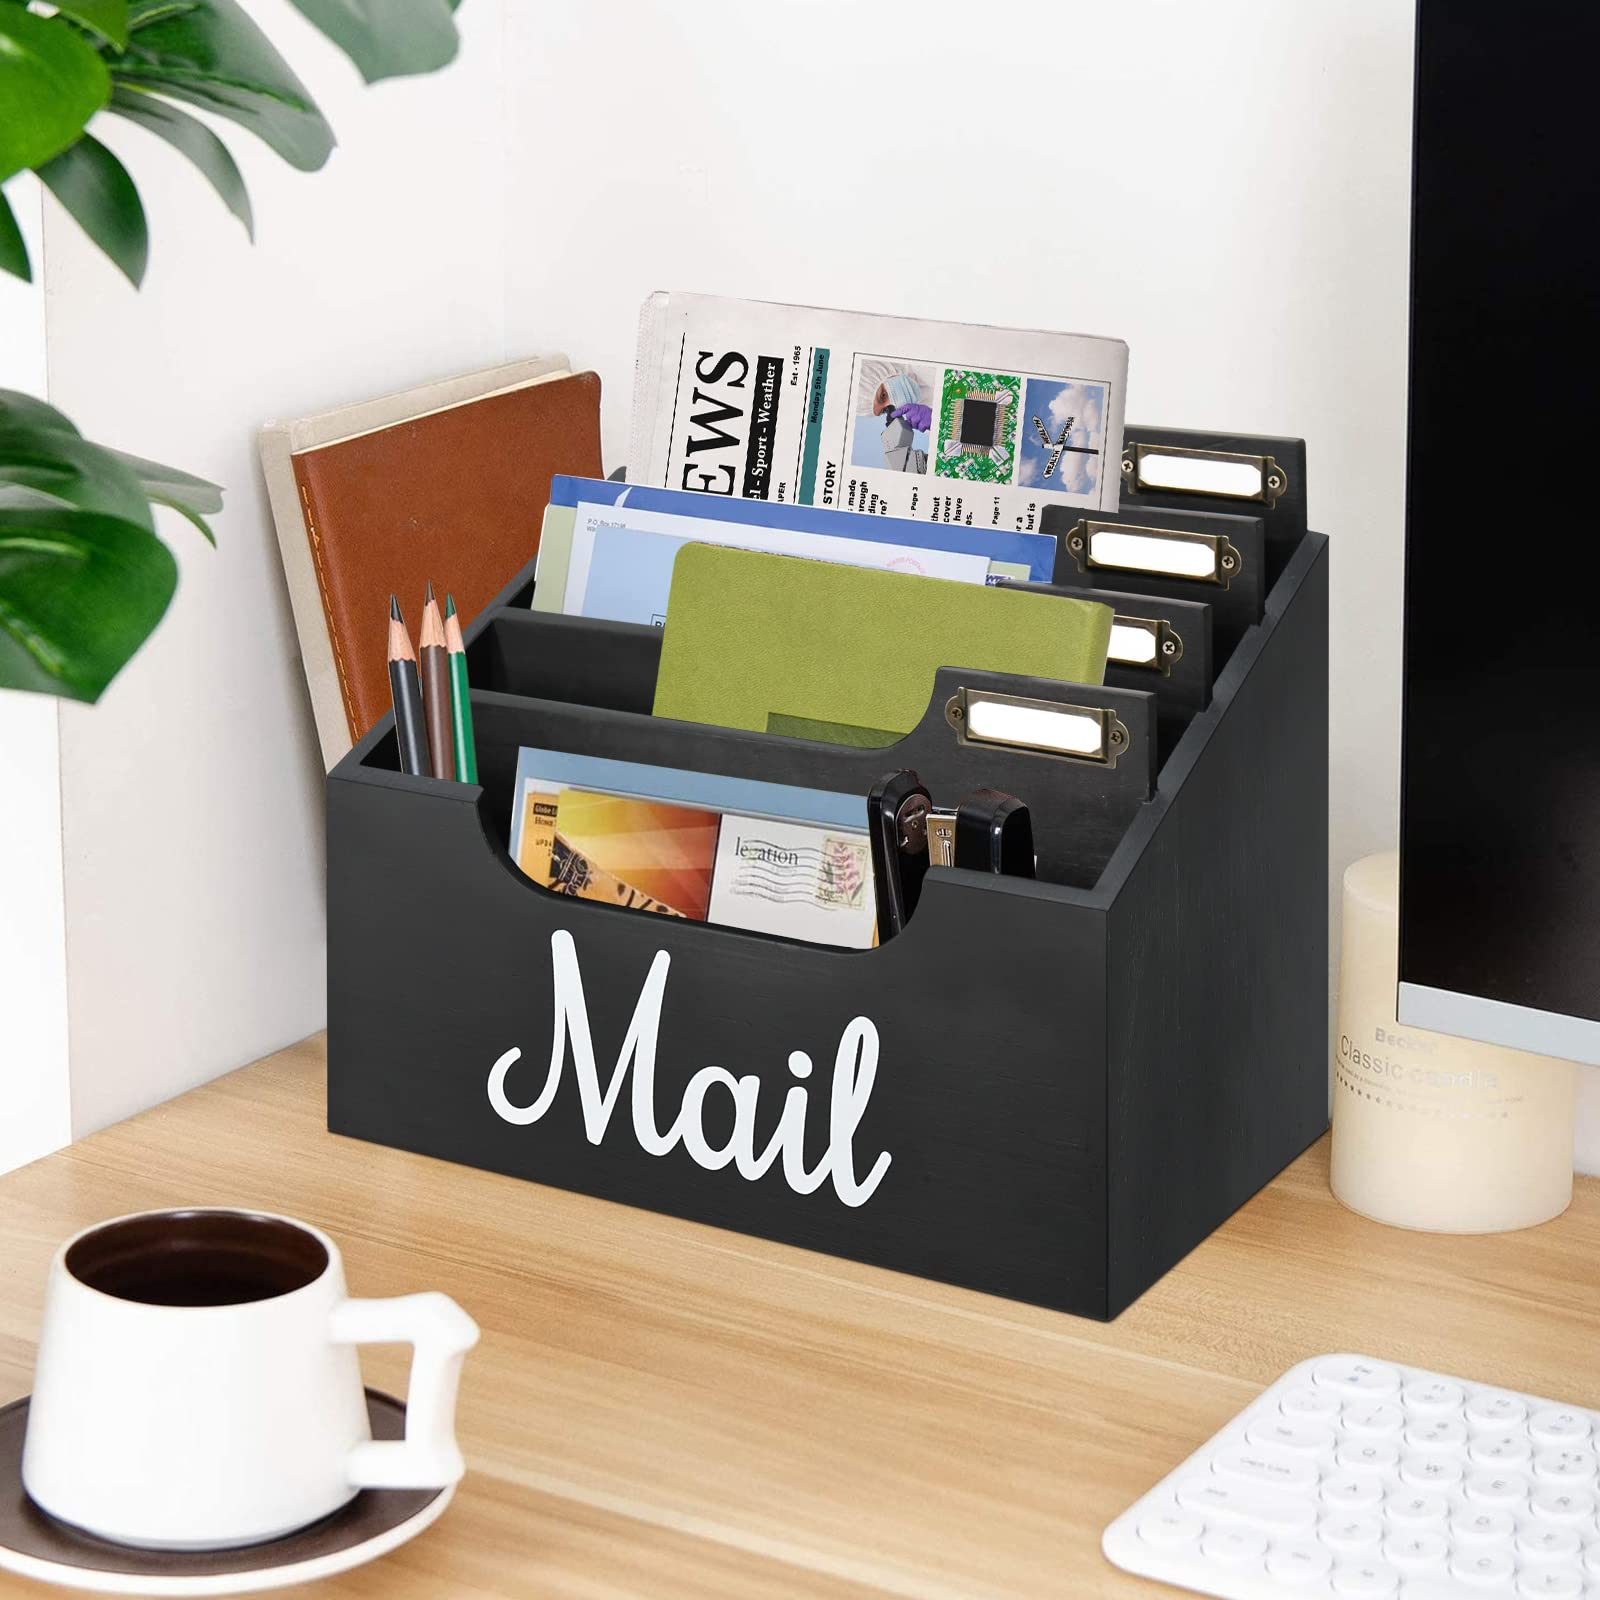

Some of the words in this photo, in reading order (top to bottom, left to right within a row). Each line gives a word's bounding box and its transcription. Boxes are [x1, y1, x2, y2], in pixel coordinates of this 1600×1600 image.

[793, 346, 801, 365] 1965
[816, 354, 825, 376] June
[791, 371, 799, 386] Est
[814, 377, 822, 390] 5th
[758, 362, 776, 424] Weather
[811, 395, 821, 424] Monday
[751, 436, 768, 477] Sport
[1044, 450, 1060, 475] WEALTH
[823, 461, 836, 505] STORY
[848, 479, 857, 506] made
[911, 492, 919, 511] Page
[943, 496, 952, 523] cover
[953, 497, 963, 521] have
[994, 496, 1000, 505] 11
[1027, 503, 1036, 512] is
[992, 508, 1001, 525] Page
[1026, 513, 1035, 531] but
[487, 929, 892, 1208] Mail
[1340, 1034, 1404, 1081] Classic
